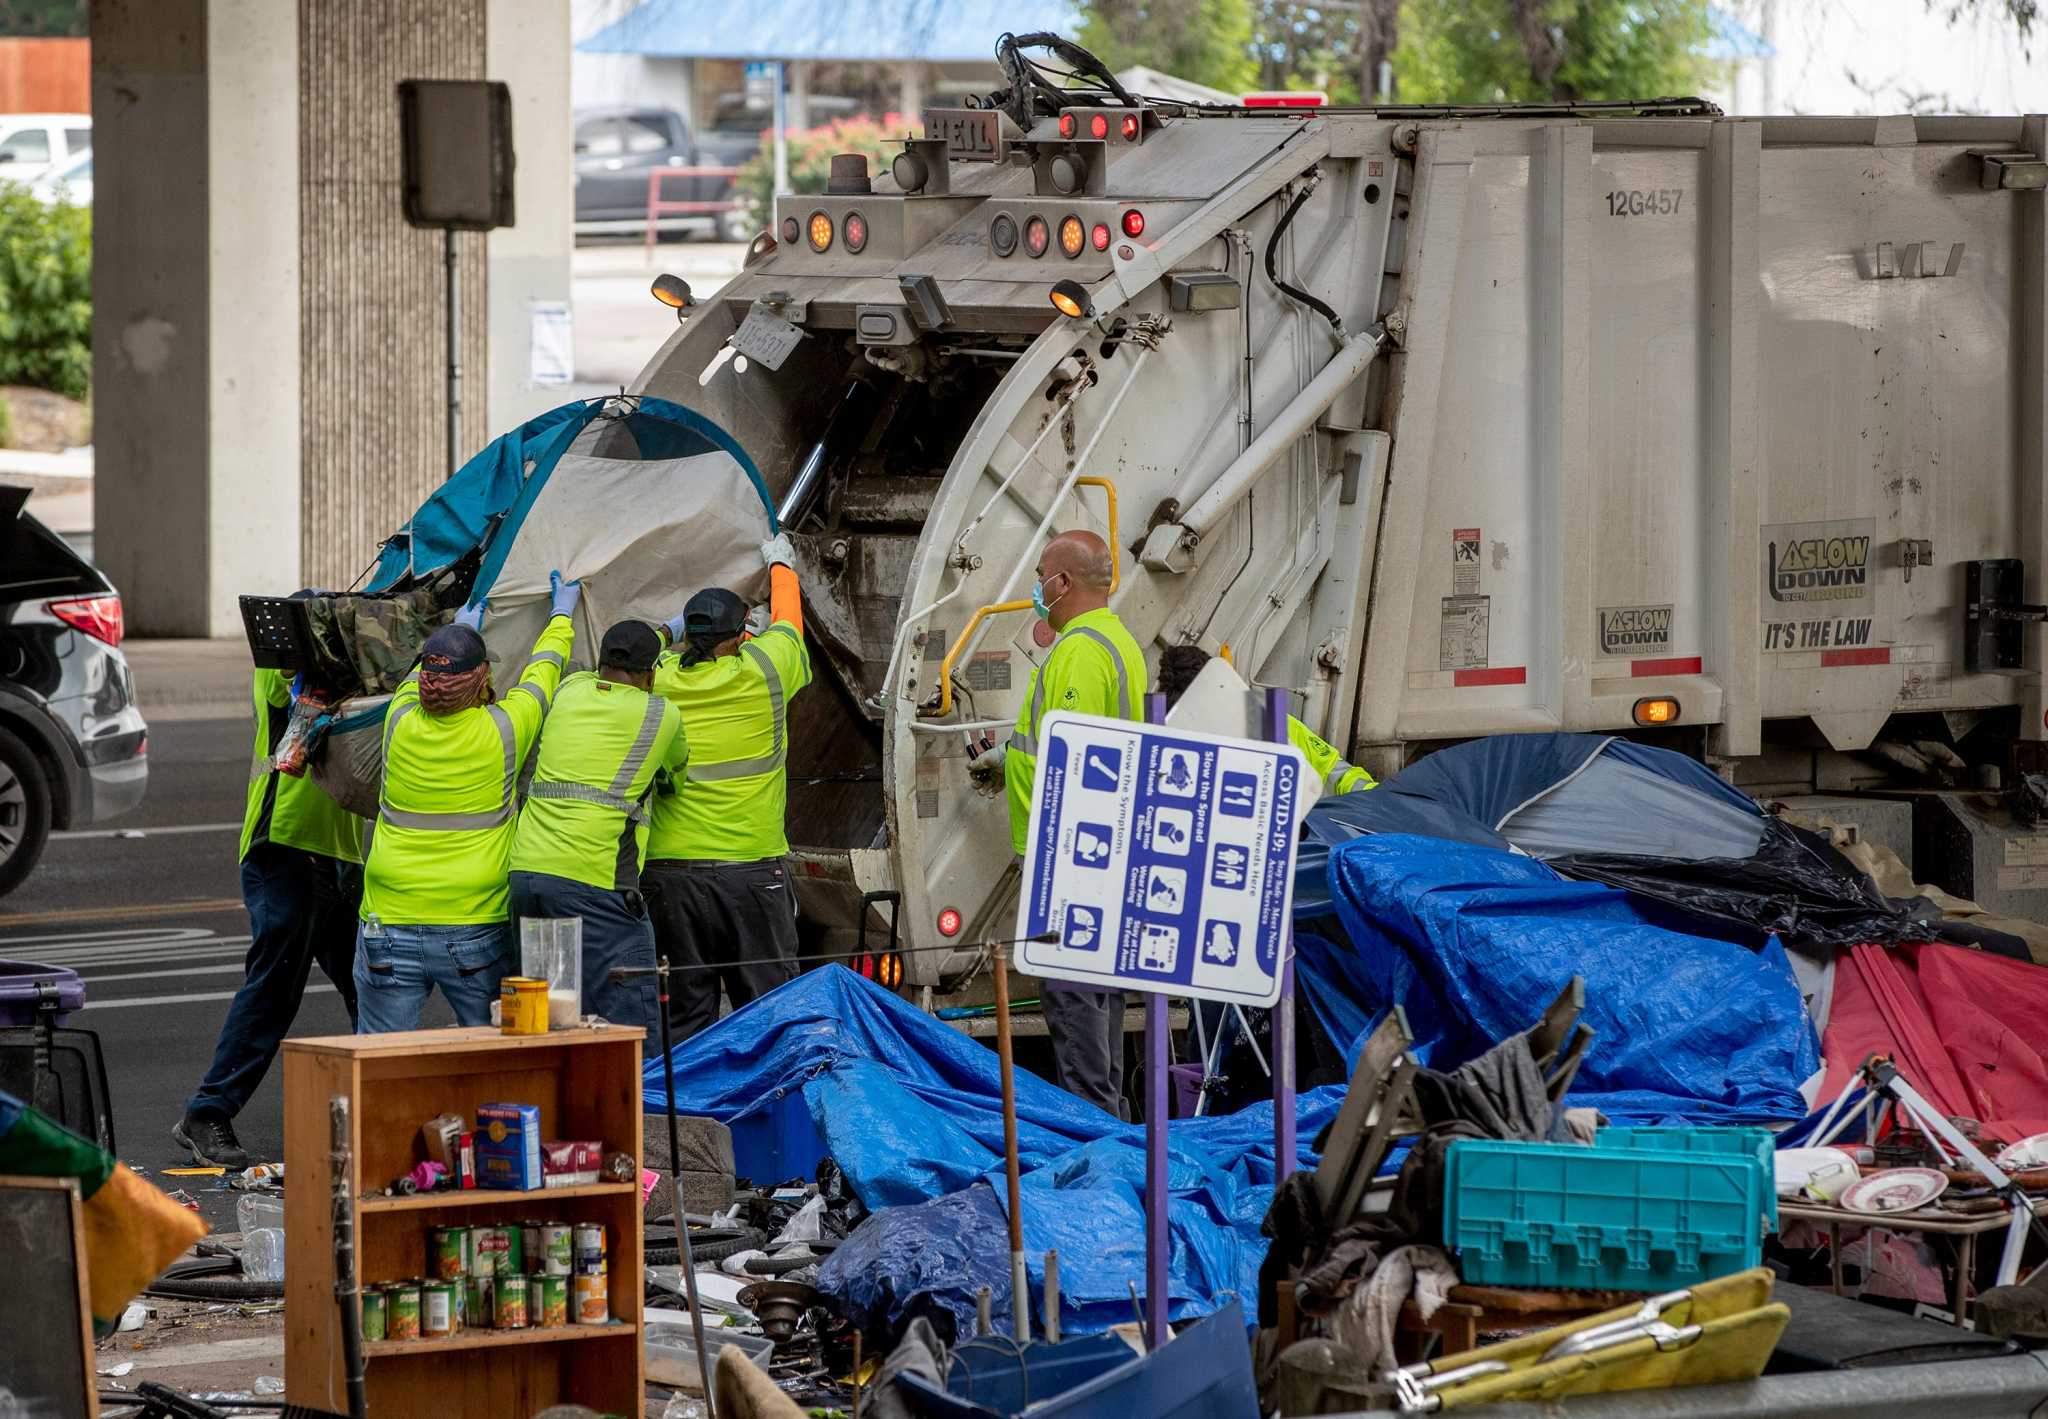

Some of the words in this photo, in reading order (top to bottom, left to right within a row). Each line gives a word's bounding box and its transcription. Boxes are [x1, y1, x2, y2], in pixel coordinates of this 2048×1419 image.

[928, 118, 994, 151] HEIL
[1605, 189, 1683, 217] 12G457
[1800, 537, 1870, 569] SLOW
[1778, 568, 1866, 590] DOWN
[1621, 609, 1671, 632] SLOW
[1765, 622, 1796, 649] IT'S
[1800, 620, 1832, 647] THE
[1834, 618, 1873, 645] LAW
[1607, 631, 1668, 646] DOWN
[1072, 752, 1081, 776] Fever
[1124, 739, 1135, 771] Know
[1148, 744, 1159, 769] Wash
[1201, 750, 1214, 779] Slow
[1122, 773, 1132, 793] the
[1145, 769, 1156, 796] Hands
[1199, 780, 1211, 800] the
[1260, 759, 1272, 797] Access
[1043, 791, 1051, 809] 3-1-1
[1271, 763, 1294, 852] COVID-19:
[1113, 795, 1129, 855] Symptoms
[1192, 802, 1208, 843] Spread
[1256, 800, 1267, 830] Basic
[1061, 827, 1073, 855] Cough
[1252, 831, 1264, 867] Needs
[1137, 864, 1147, 887] Wear
[1265, 857, 1276, 887] Access
[1275, 859, 1285, 877] Stay
[1126, 866, 1139, 903] Covering
[1249, 870, 1259, 897] Here
[1273, 879, 1283, 898] Safe
[1135, 888, 1144, 907] Face
[1261, 888, 1272, 925] Services
[1130, 919, 1141, 938] Stay
[1269, 906, 1280, 929] Meet
[1122, 929, 1131, 947] Feet
[1266, 930, 1277, 959] Needs
[1117, 947, 1129, 972] Away
[1127, 948, 1137, 970] Least
